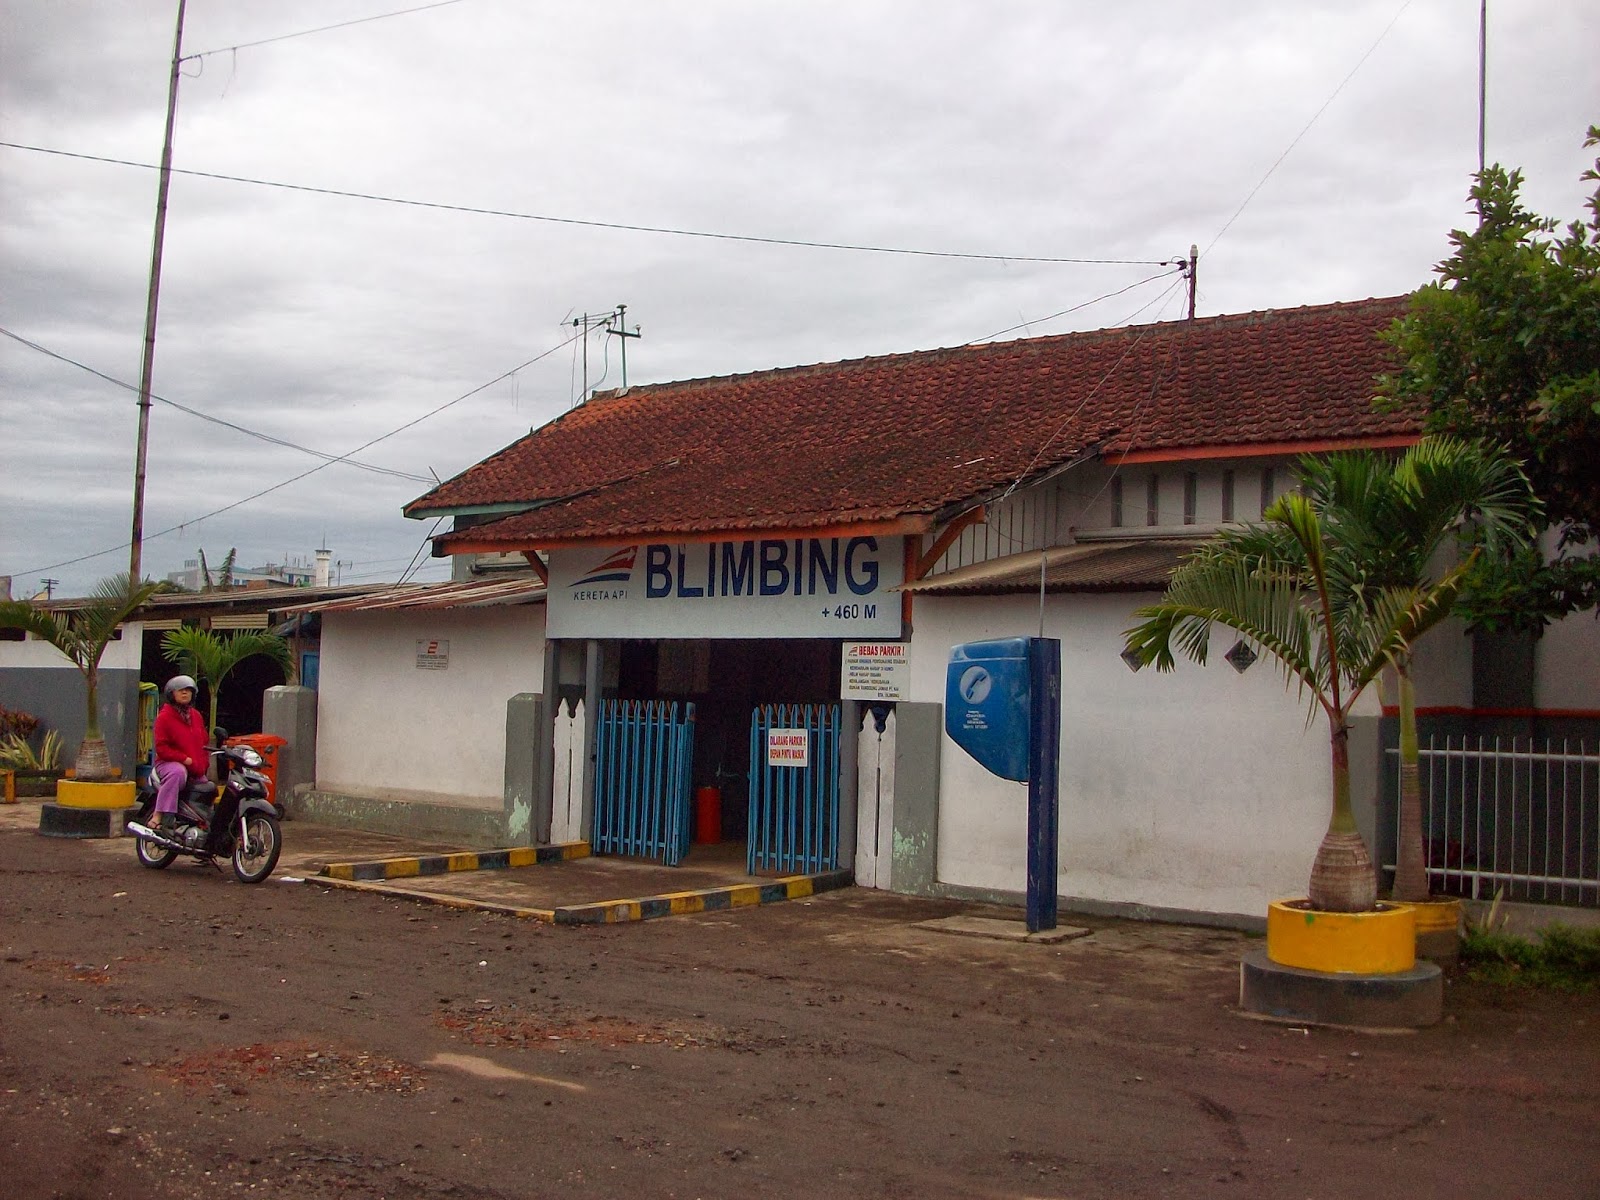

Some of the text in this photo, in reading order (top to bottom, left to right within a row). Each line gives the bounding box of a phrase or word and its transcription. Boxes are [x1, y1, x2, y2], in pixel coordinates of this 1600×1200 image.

[646, 535, 879, 599] BLIMBING
[834, 603, 859, 620] 460
[864, 604, 876, 619] M
[859, 645, 878, 656] BEBAS
[880, 646, 901, 656] PARKIR
